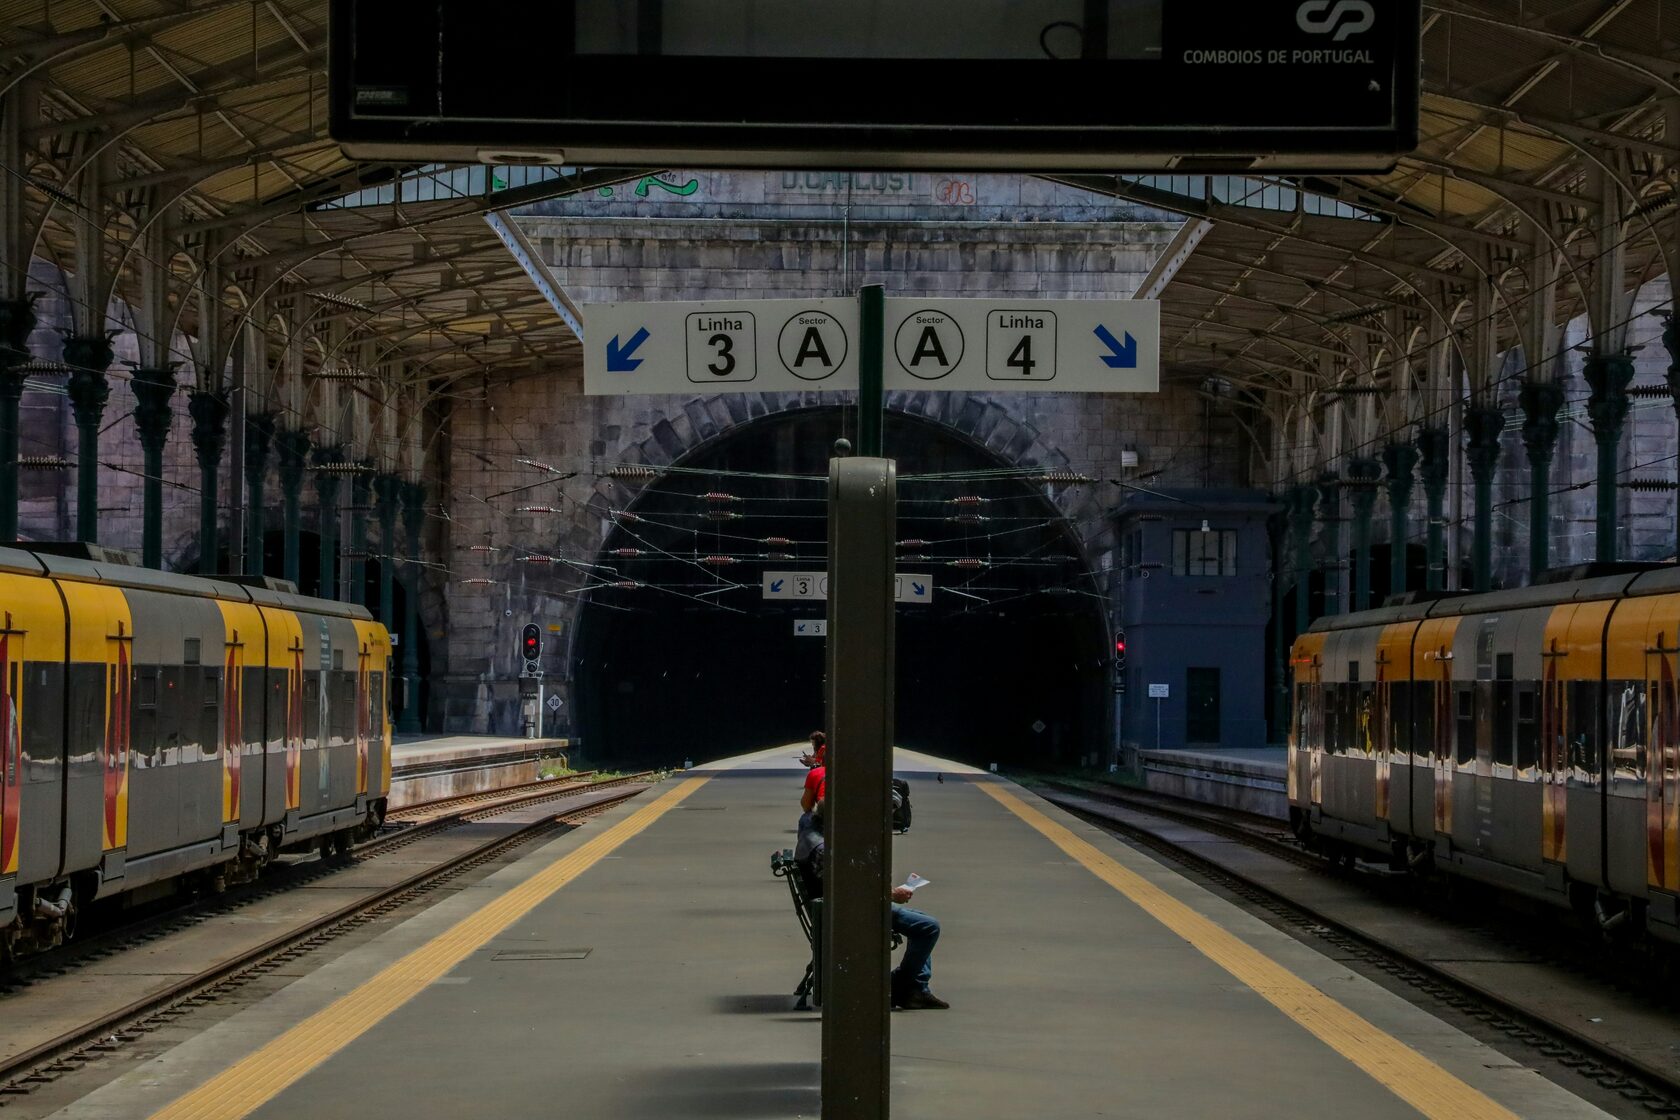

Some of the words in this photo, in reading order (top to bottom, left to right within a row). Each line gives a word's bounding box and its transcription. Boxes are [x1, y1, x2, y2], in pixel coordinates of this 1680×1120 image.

[1183, 50, 1263, 64] COMBOIOS
[1267, 50, 1287, 64] DE
[1292, 50, 1375, 64] PORTUGAL
[698, 318, 743, 331] Linha
[799, 317, 827, 325] Sector
[916, 316, 944, 324] Sector
[1000, 315, 1044, 328] Linha
[793, 326, 833, 367] A
[909, 326, 950, 366] A
[708, 333, 736, 377] 3
[1006, 335, 1036, 375] 4
[799, 581, 808, 595] 3
[815, 625, 820, 633] 3
[550, 698, 560, 707] 30
